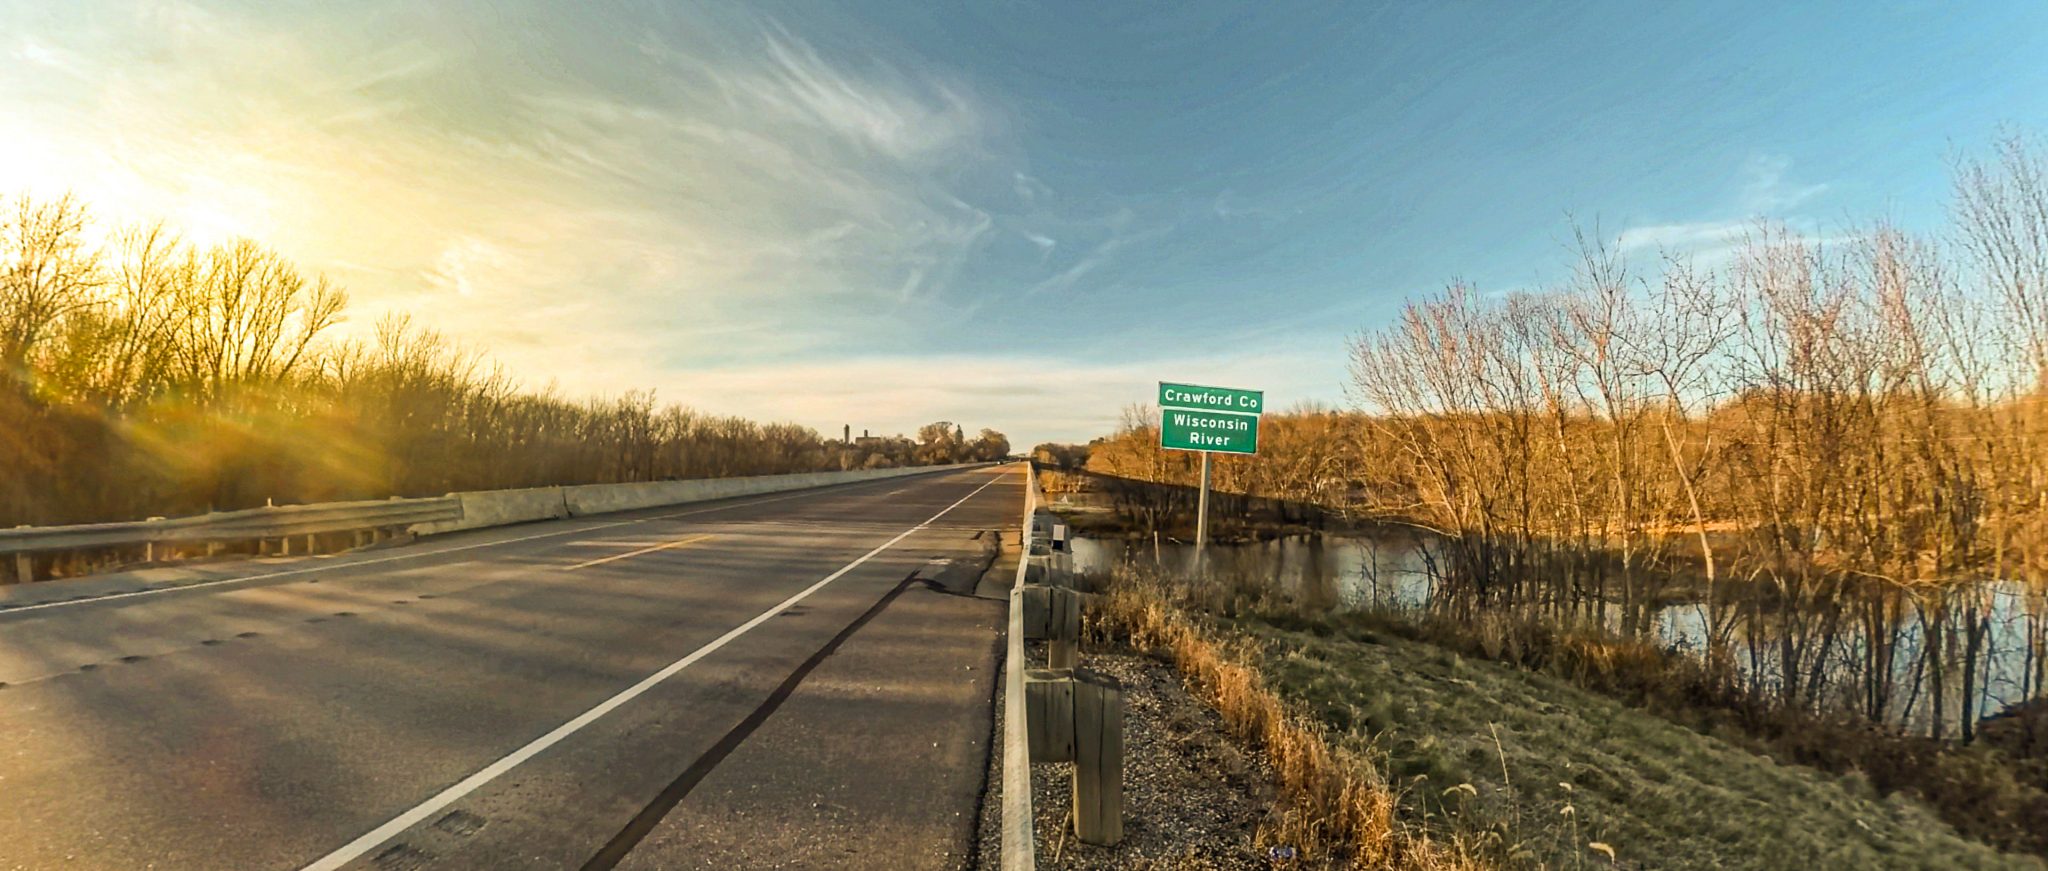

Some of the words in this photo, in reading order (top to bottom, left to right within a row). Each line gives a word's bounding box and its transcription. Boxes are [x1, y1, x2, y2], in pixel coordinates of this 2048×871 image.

[1165, 389, 1232, 406] Crawford
[1240, 396, 1258, 408] Co
[1174, 413, 1248, 431] Wisconsin
[1189, 432, 1230, 446] River
